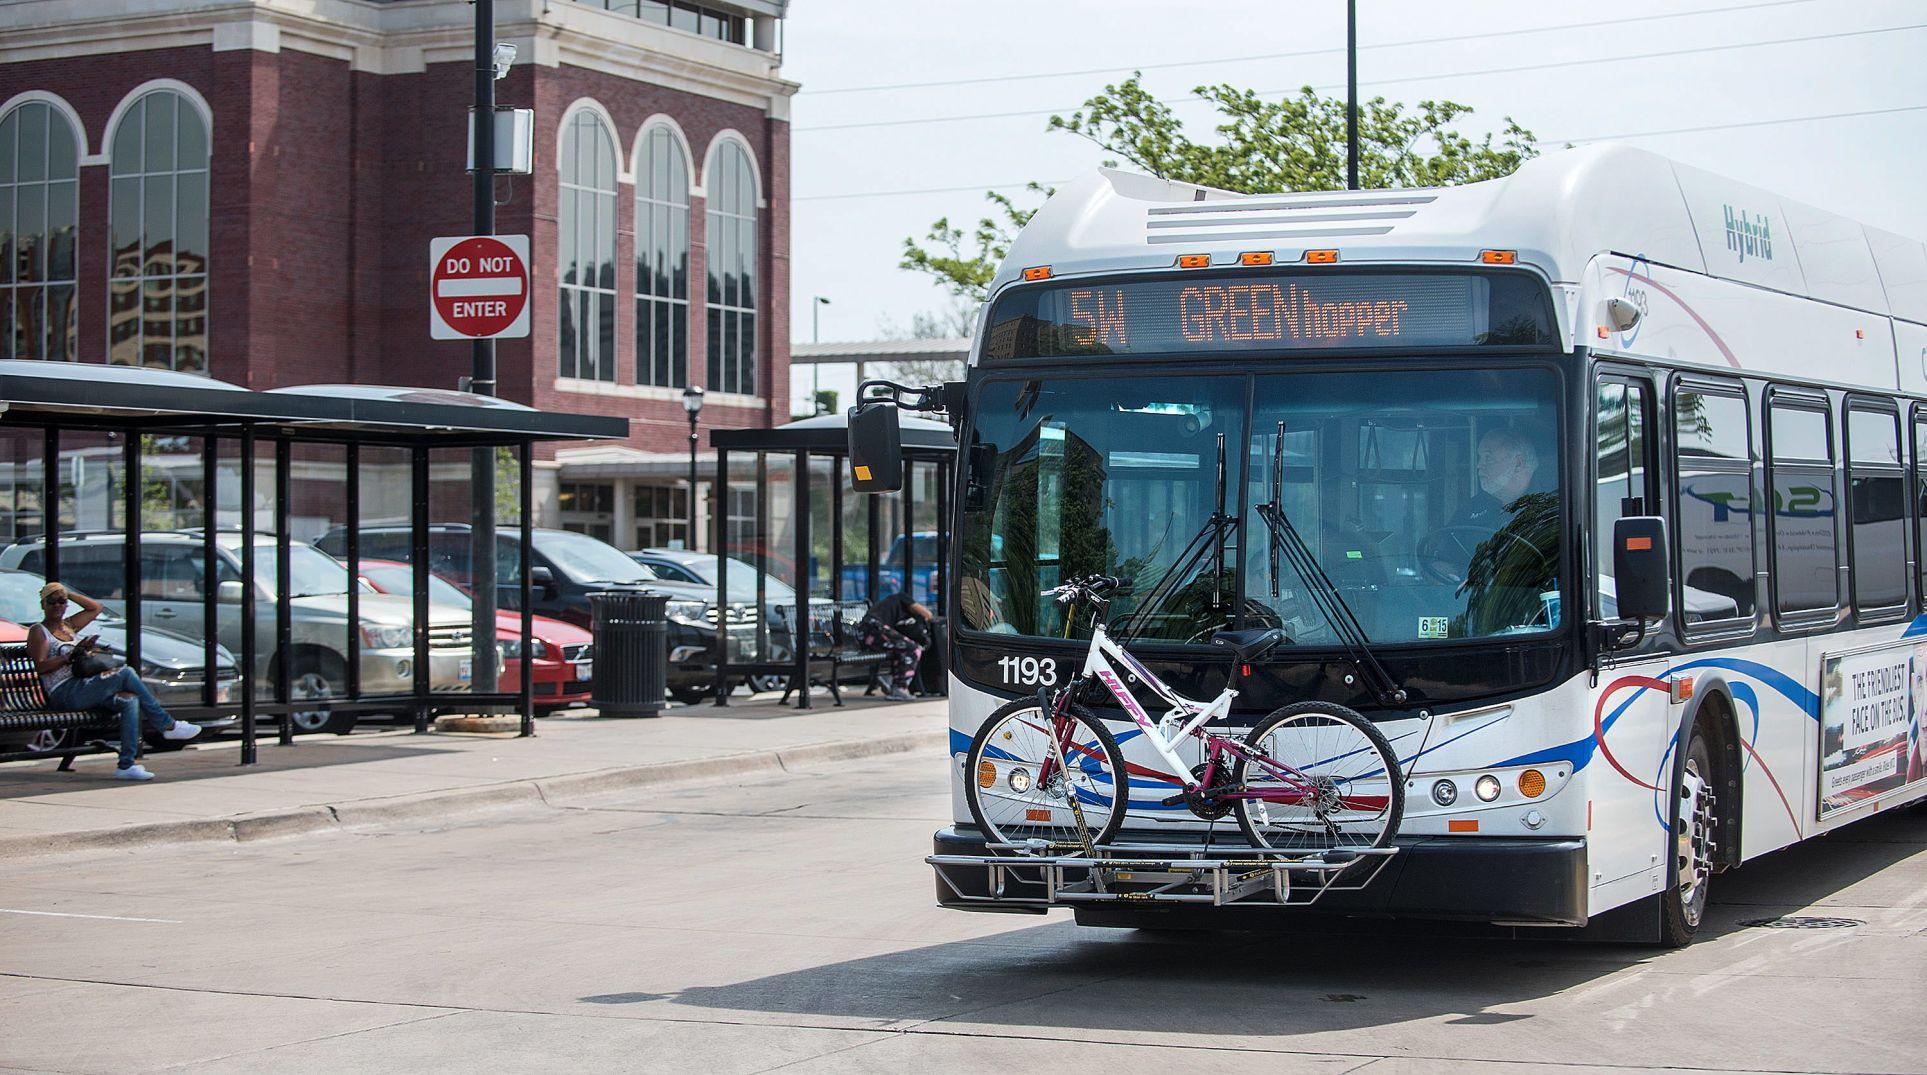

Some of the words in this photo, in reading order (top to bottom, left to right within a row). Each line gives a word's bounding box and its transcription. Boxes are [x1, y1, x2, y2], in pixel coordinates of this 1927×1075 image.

[1723, 203, 1773, 263] Hybrid
[446, 258, 471, 274] DO
[479, 257, 514, 273] NOT
[453, 301, 508, 318] ENTER
[1071, 290, 1126, 346] 5W
[1421, 619, 1429, 632] 6
[1437, 619, 1447, 632] 15
[998, 656, 1057, 686] 1193
[1852, 672, 1867, 701] THE
[1867, 664, 1905, 698] FRIENDLIEST
[1099, 671, 1153, 728] HUFFY
[1851, 705, 1869, 736] FACE
[1870, 701, 1880, 731] ON
[1881, 699, 1892, 727] THE
